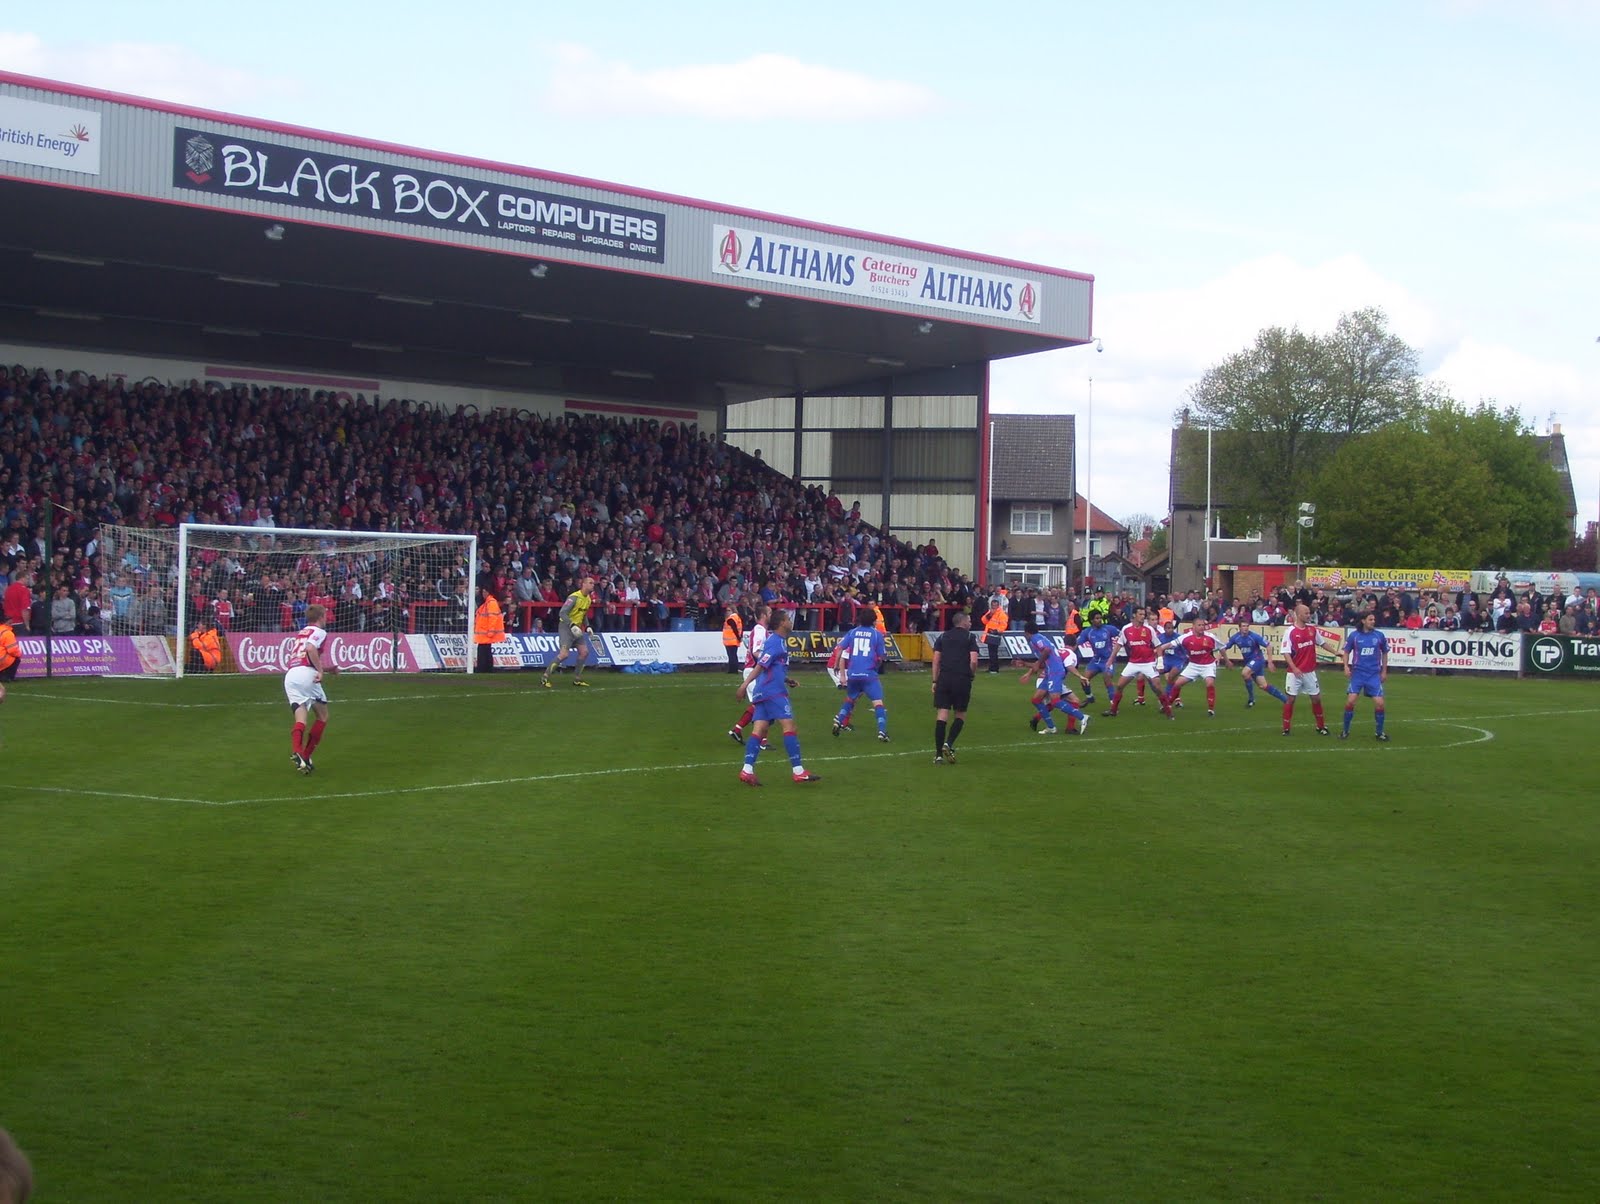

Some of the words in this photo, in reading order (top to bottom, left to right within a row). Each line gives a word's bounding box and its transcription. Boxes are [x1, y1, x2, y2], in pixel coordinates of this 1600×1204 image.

[36, 133, 80, 157] Energy
[221, 144, 381, 210] BLACK
[392, 174, 490, 227] BOX
[498, 193, 658, 241] COMPUTERS
[497, 221, 536, 235] LAPTOPS
[542, 228, 576, 241] REPAIRS
[582, 234, 624, 249] UPGRADES
[629, 243, 657, 254] ONSITE
[745, 235, 856, 287] ALTHAMS
[862, 256, 918, 280] Catering
[869, 271, 910, 287] Butchers
[920, 266, 1013, 313] ALTHAMS
[1345, 570, 1385, 580] Jubilee
[1388, 570, 1430, 582] Garage
[83, 639, 114, 654] SPA
[440, 647, 468, 656] 0152
[610, 635, 660, 649] Bateman
[852, 637, 871, 657] 14
[1004, 635, 1032, 655] RB
[1421, 639, 1514, 658] ROOFING
[1570, 639, 1600, 656] Tra
[330, 636, 408, 671] Coca-Cola
[1430, 657, 1473, 666] 423186
[1536, 645, 1560, 664] TP
